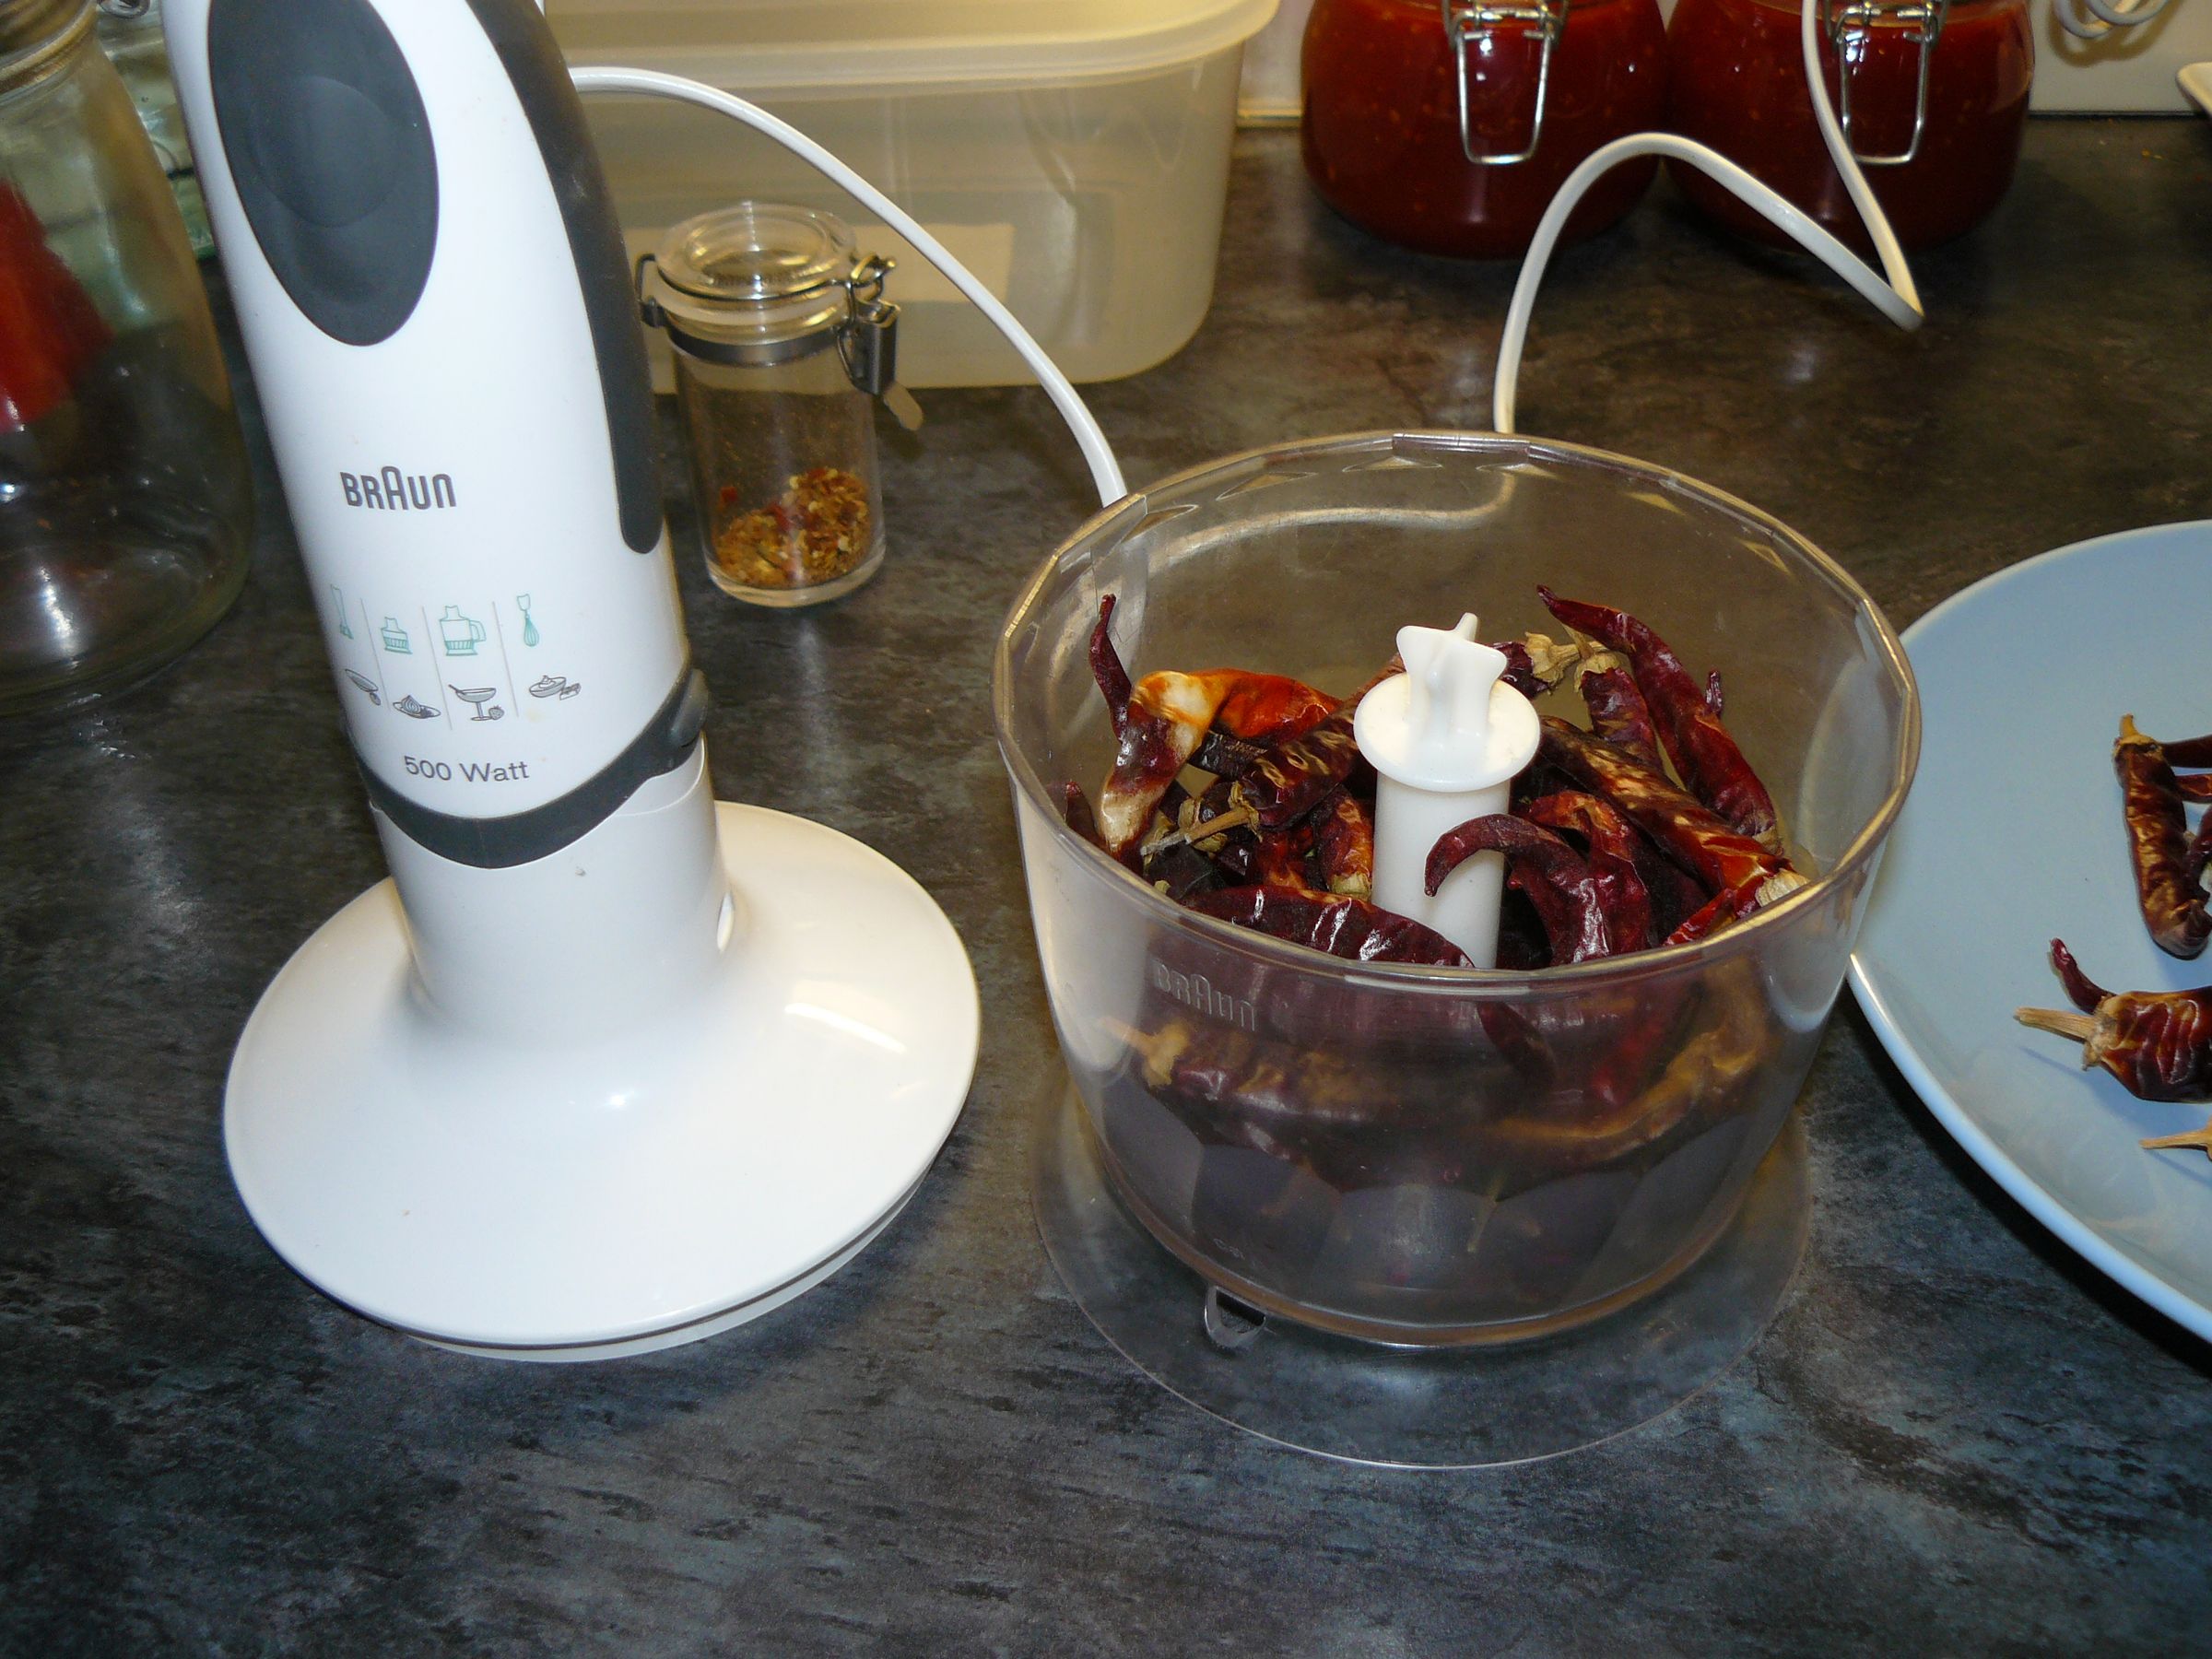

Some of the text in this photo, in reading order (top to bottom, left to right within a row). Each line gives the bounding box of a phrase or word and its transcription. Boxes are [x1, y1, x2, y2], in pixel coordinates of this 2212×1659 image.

[340, 465, 457, 511] BRAUN
[404, 755, 530, 782] 500 Watt
